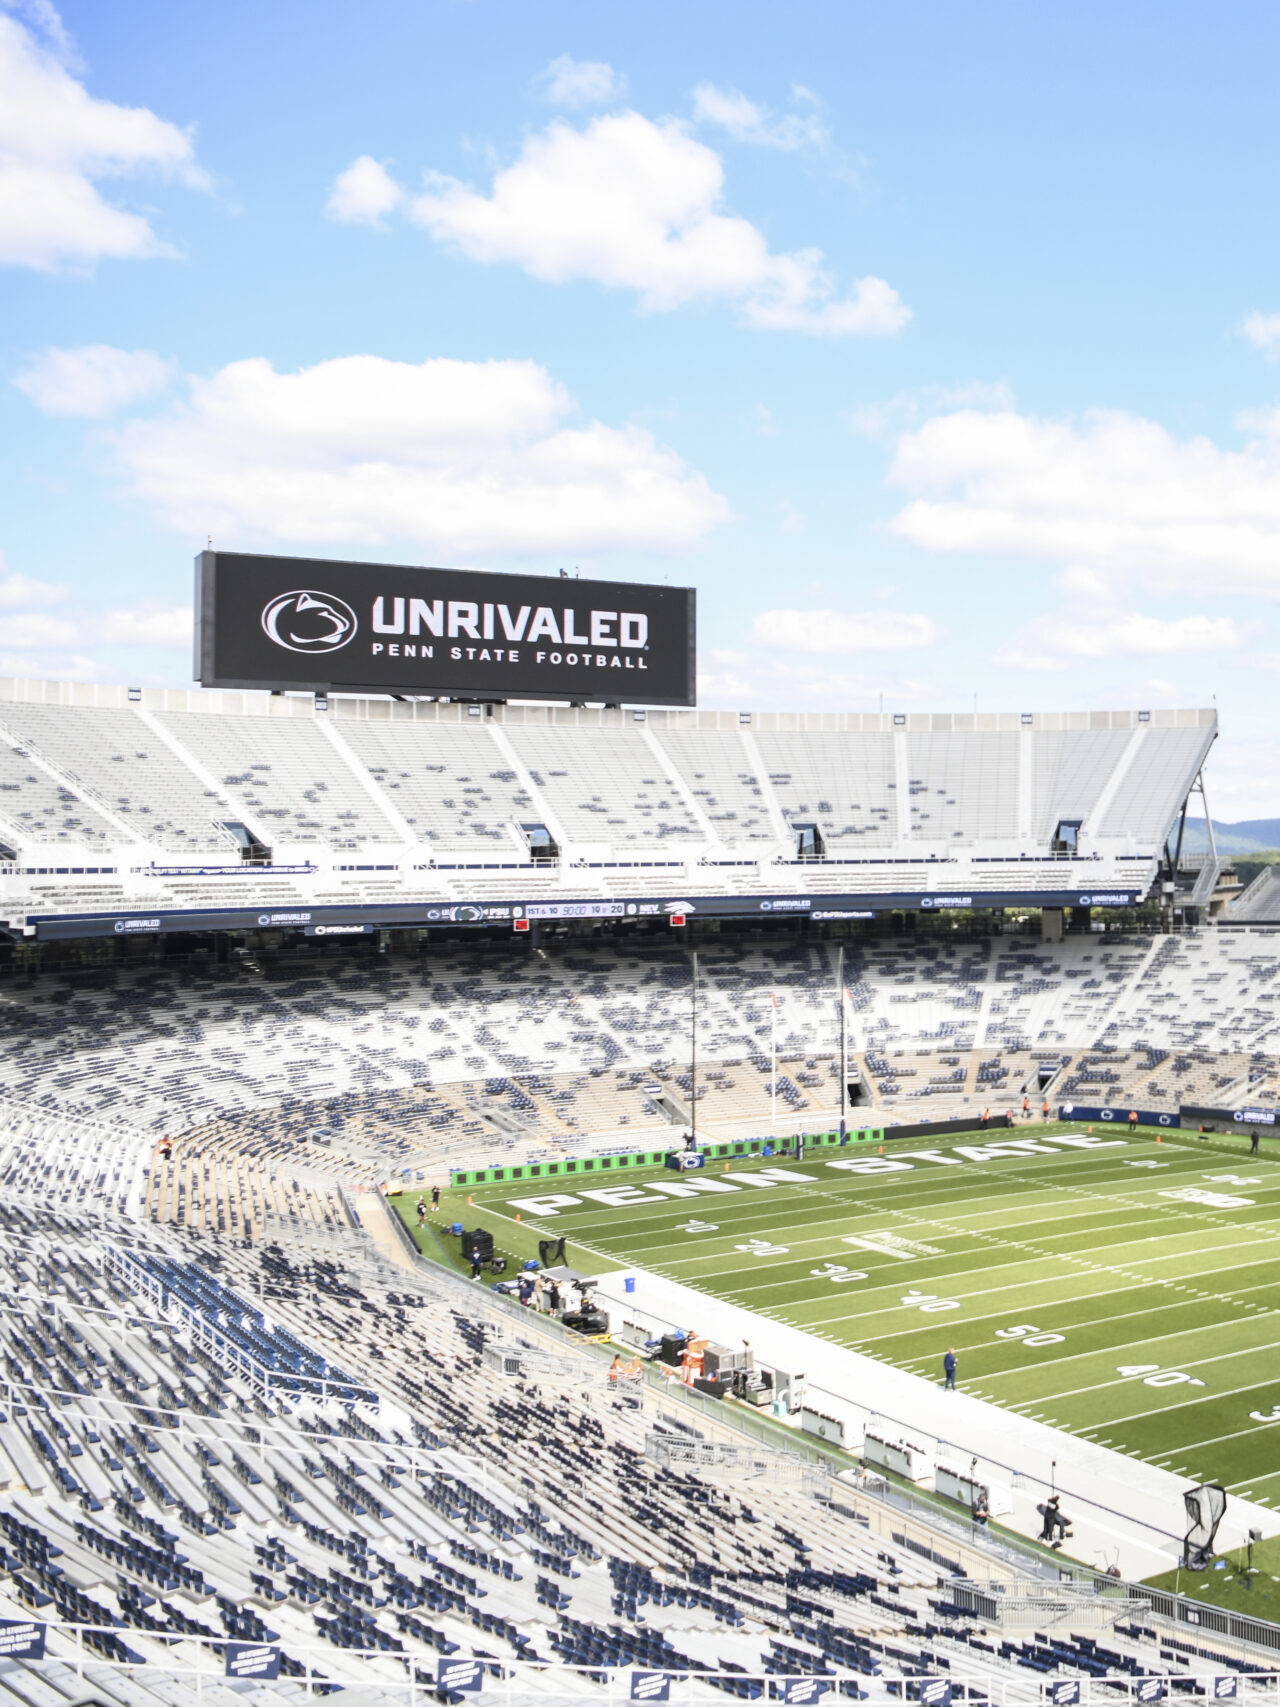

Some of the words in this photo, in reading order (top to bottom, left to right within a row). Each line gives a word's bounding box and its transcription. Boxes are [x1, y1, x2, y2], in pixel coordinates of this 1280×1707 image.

[372, 596, 649, 649] UNRIVALED
[372, 643, 435, 658] PENN
[451, 647, 520, 663] STATE
[537, 651, 649, 669] FOOTBALL
[933, 896, 972, 904] UNRIVALED
[1091, 894, 1129, 902] UNRIVALED
[271, 913, 311, 921] UNRIVALED
[611, 905, 623, 913] 20
[125, 919, 161, 928] UNRIVALED
[505, 1168, 820, 1217] PENN
[825, 1134, 1129, 1175] STATE
[734, 1241, 790, 1257] 20
[809, 1265, 870, 1283] 30
[900, 1295, 961, 1313] 40
[994, 1324, 1067, 1347] 50
[1115, 1364, 1191, 1388] 40
